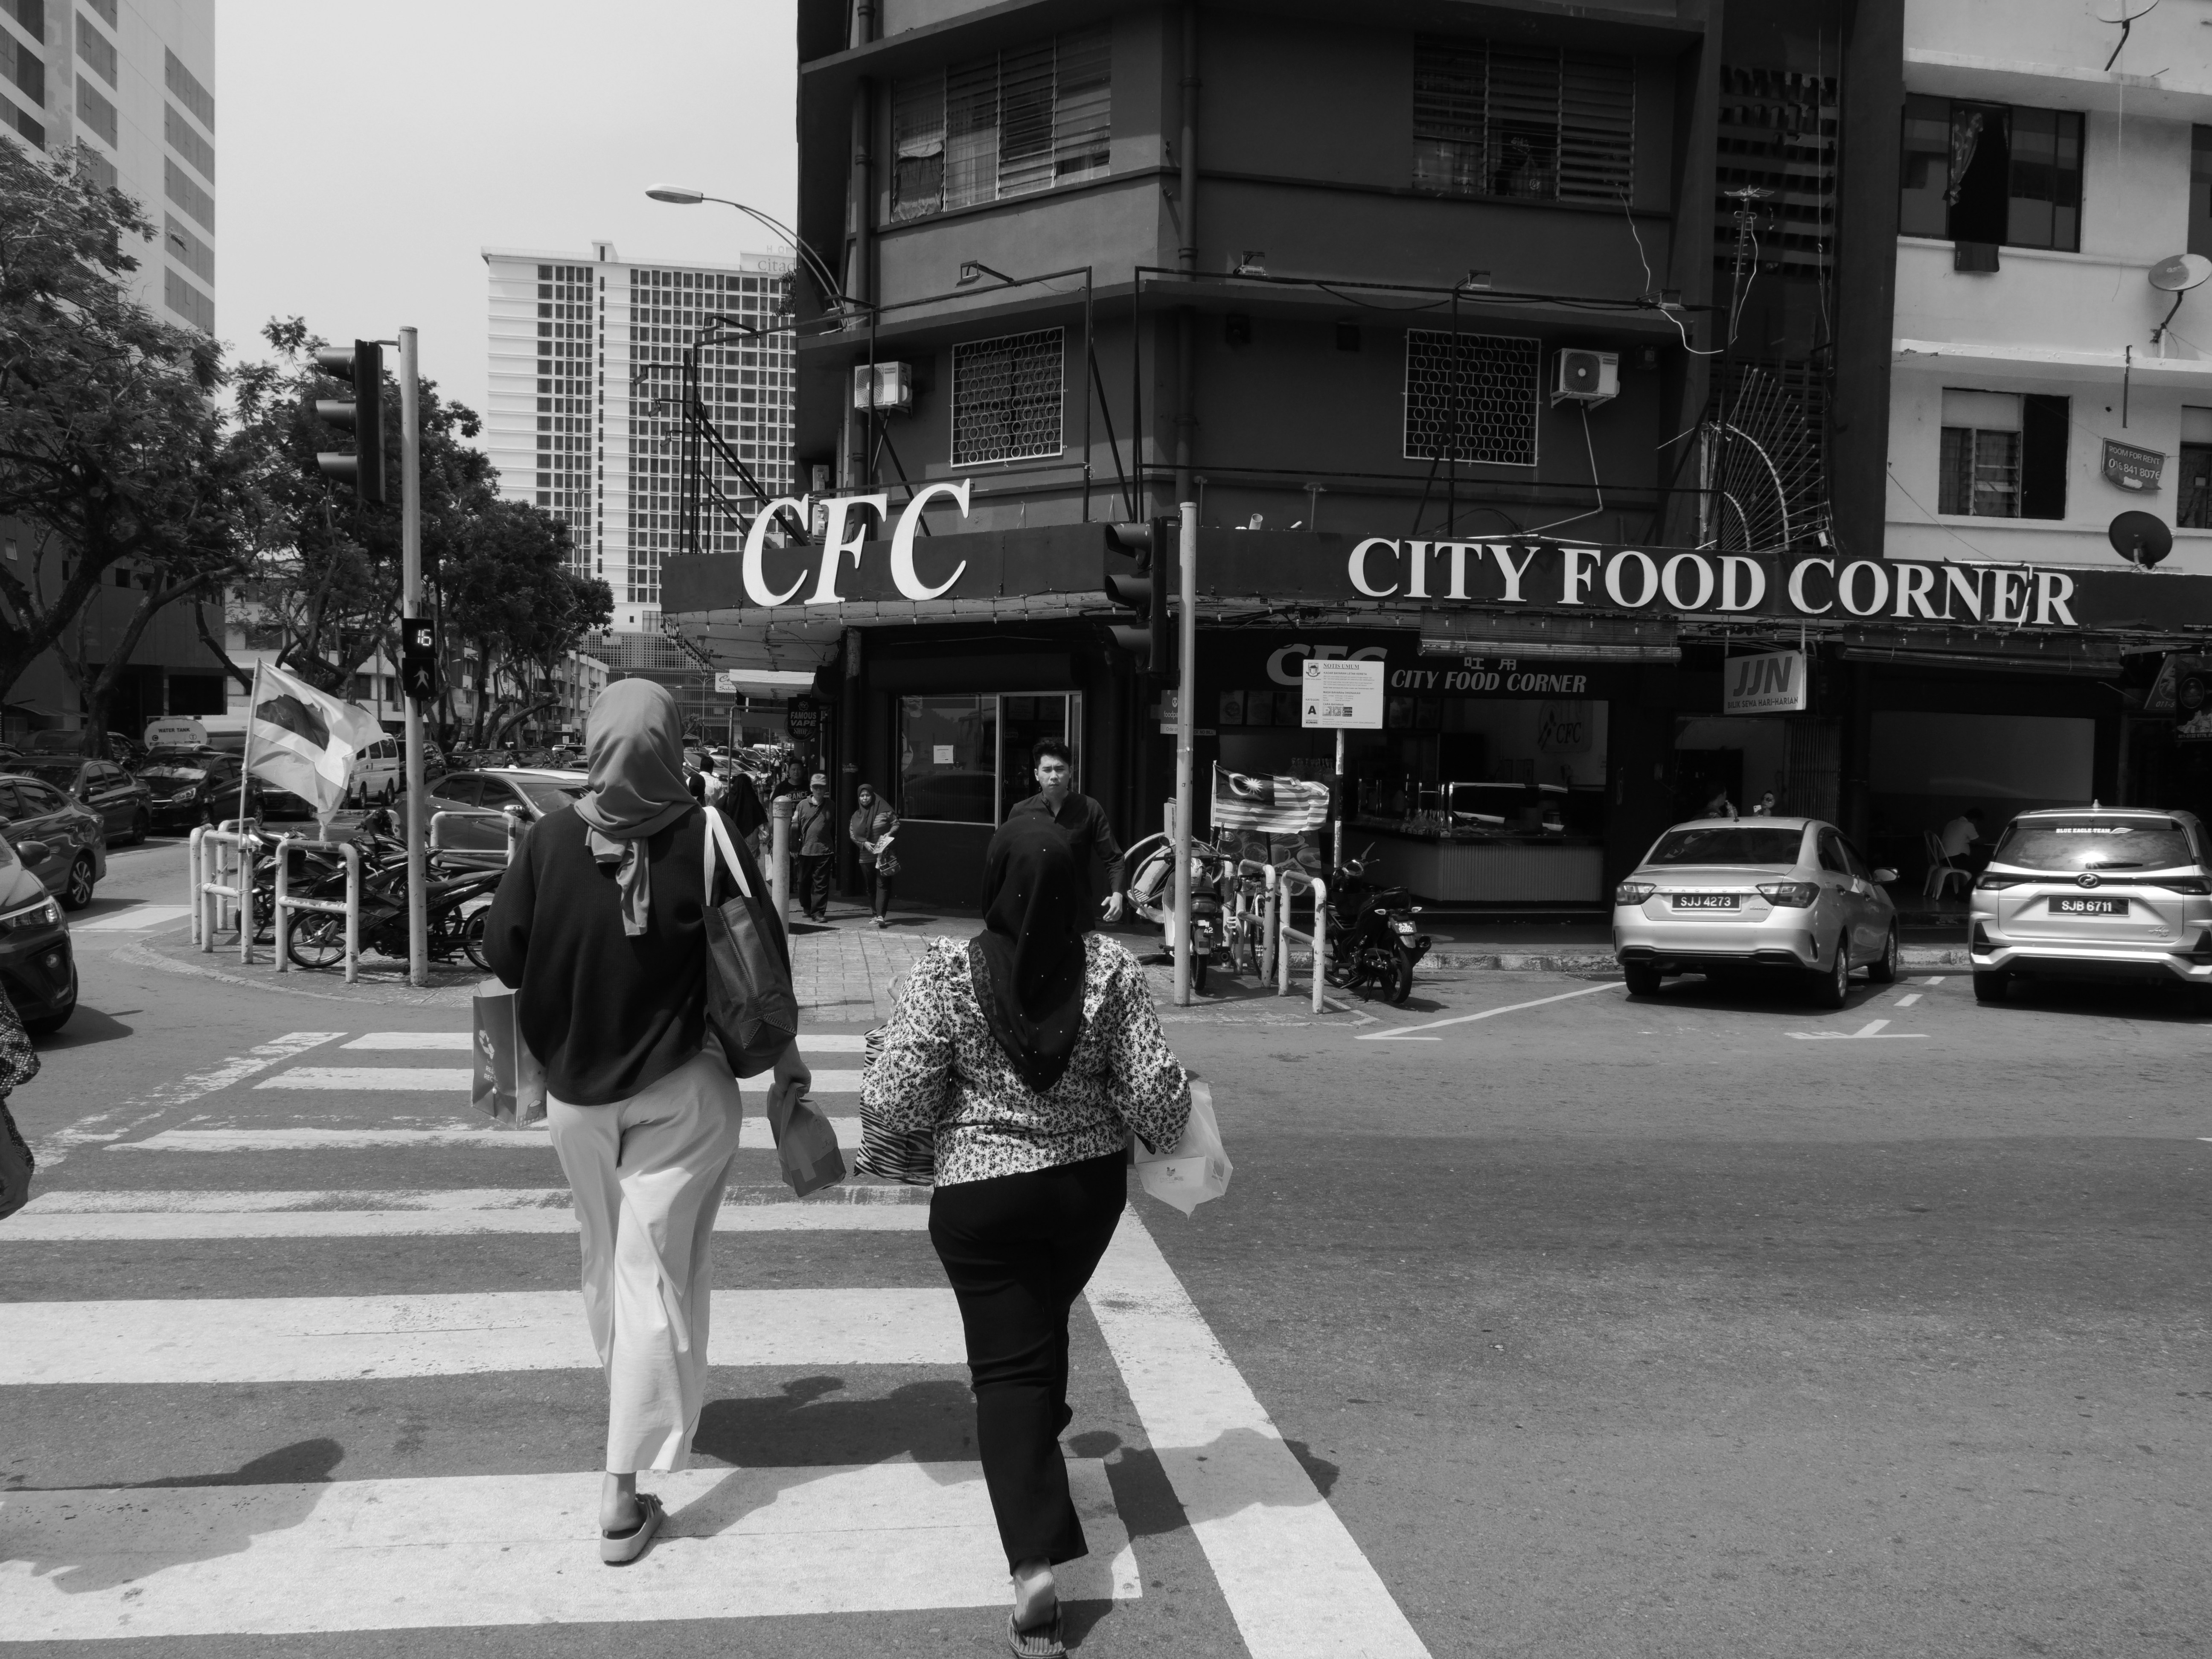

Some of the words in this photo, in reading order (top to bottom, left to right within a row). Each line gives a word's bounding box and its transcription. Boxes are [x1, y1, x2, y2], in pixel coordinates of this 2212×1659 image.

[2109, 445, 2129, 458] ROOM
[2129, 450, 2142, 460] FOR
[2142, 455, 2160, 465] RENT
[2108, 458, 2123, 471] 016
[2124, 464, 2138, 475] 841
[2139, 469, 2160, 480] 8076
[742, 478, 970, 607] CFC
[1348, 538, 1541, 602] CITY
[1557, 548, 1765, 612] FOOD
[1788, 558, 2078, 626] CORNER
[417, 629, 431, 646] 16
[1391, 669, 1439, 689] CITY
[1445, 672, 1499, 690] FOOD
[1507, 673, 1587, 693] CORNER
[1733, 657, 1793, 697] JJN
[1308, 705, 1316, 715] A
[1741, 700, 1757, 708] SEWA
[1758, 696, 1799, 707] HARI-HARIAN
[1556, 722, 1582, 743] CFC
[1680, 896, 1701, 906] SJJ
[1703, 896, 1731, 906] 4273
[2061, 900, 2085, 911] SJB
[2086, 901, 2112, 912] 6711
